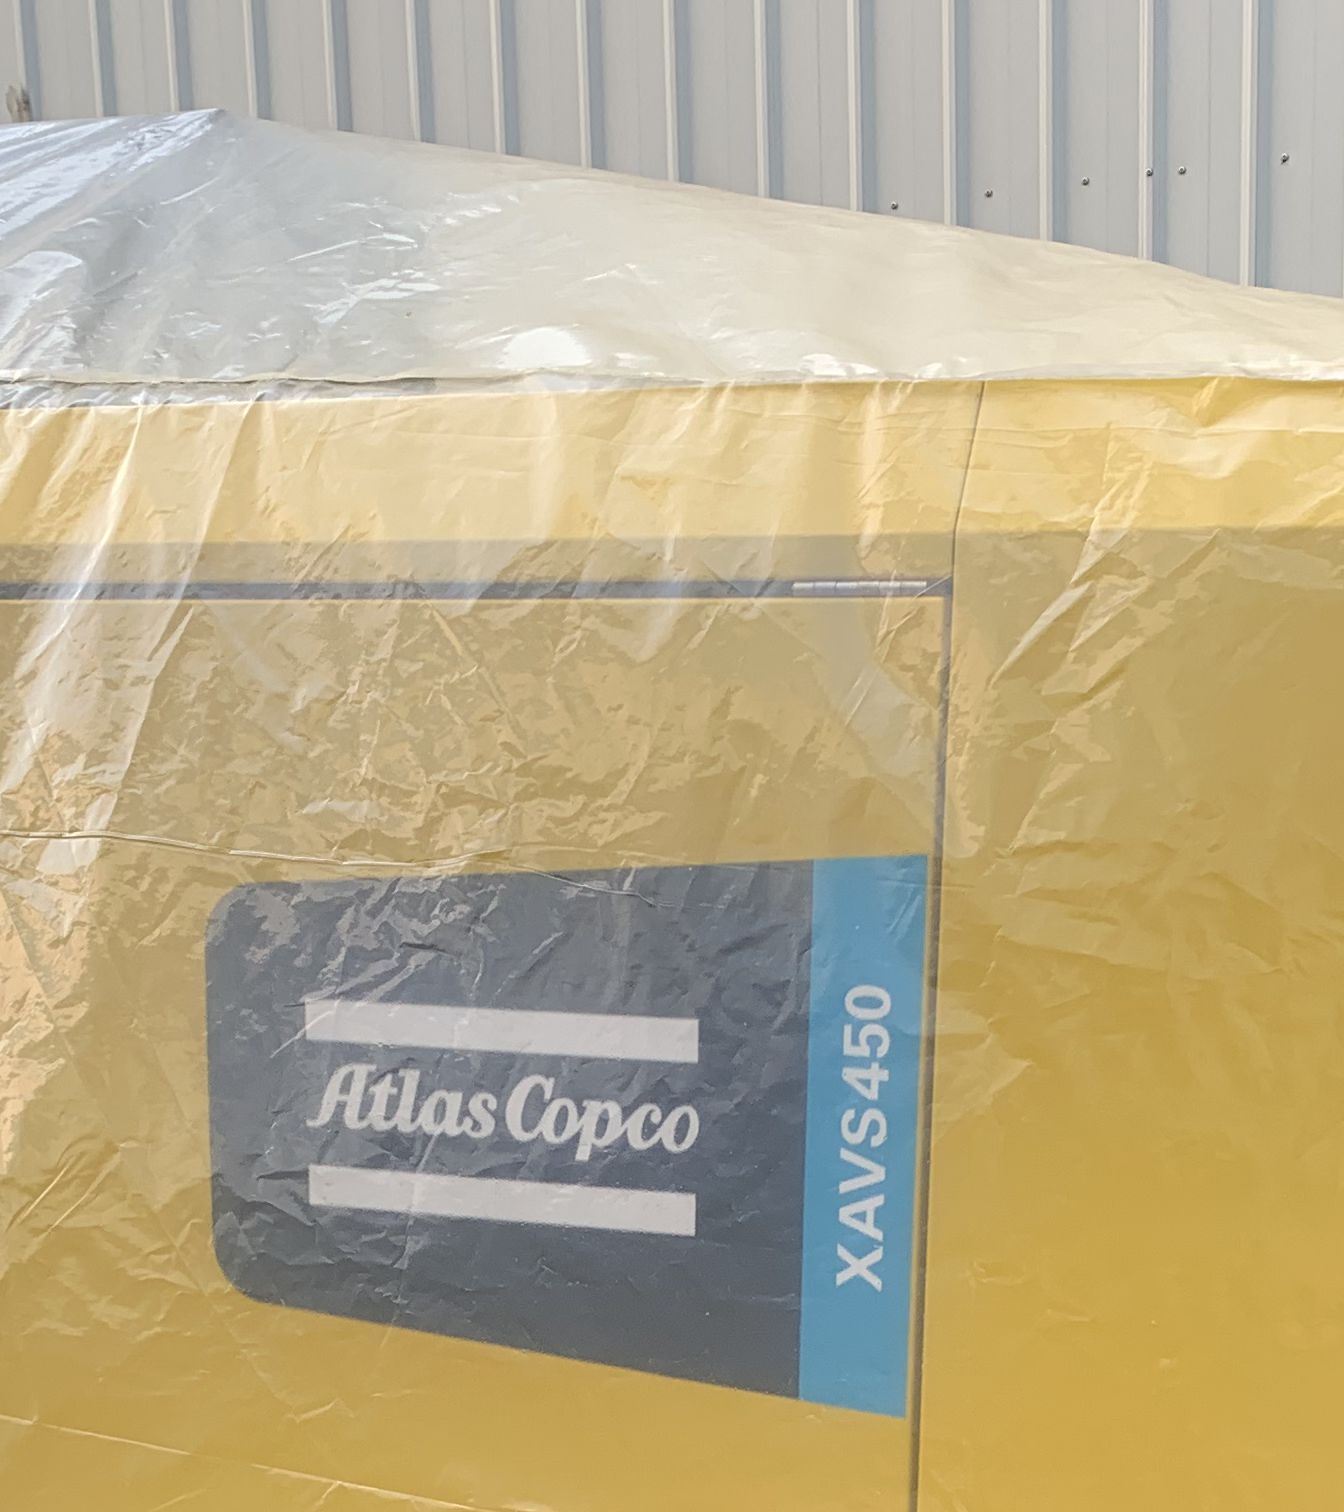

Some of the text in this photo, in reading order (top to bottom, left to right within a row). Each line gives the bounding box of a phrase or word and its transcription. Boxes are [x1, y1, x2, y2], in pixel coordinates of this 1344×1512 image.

[306, 1062, 700, 1161] Atlas Copco
[836, 984, 892, 1293] XAVS450
